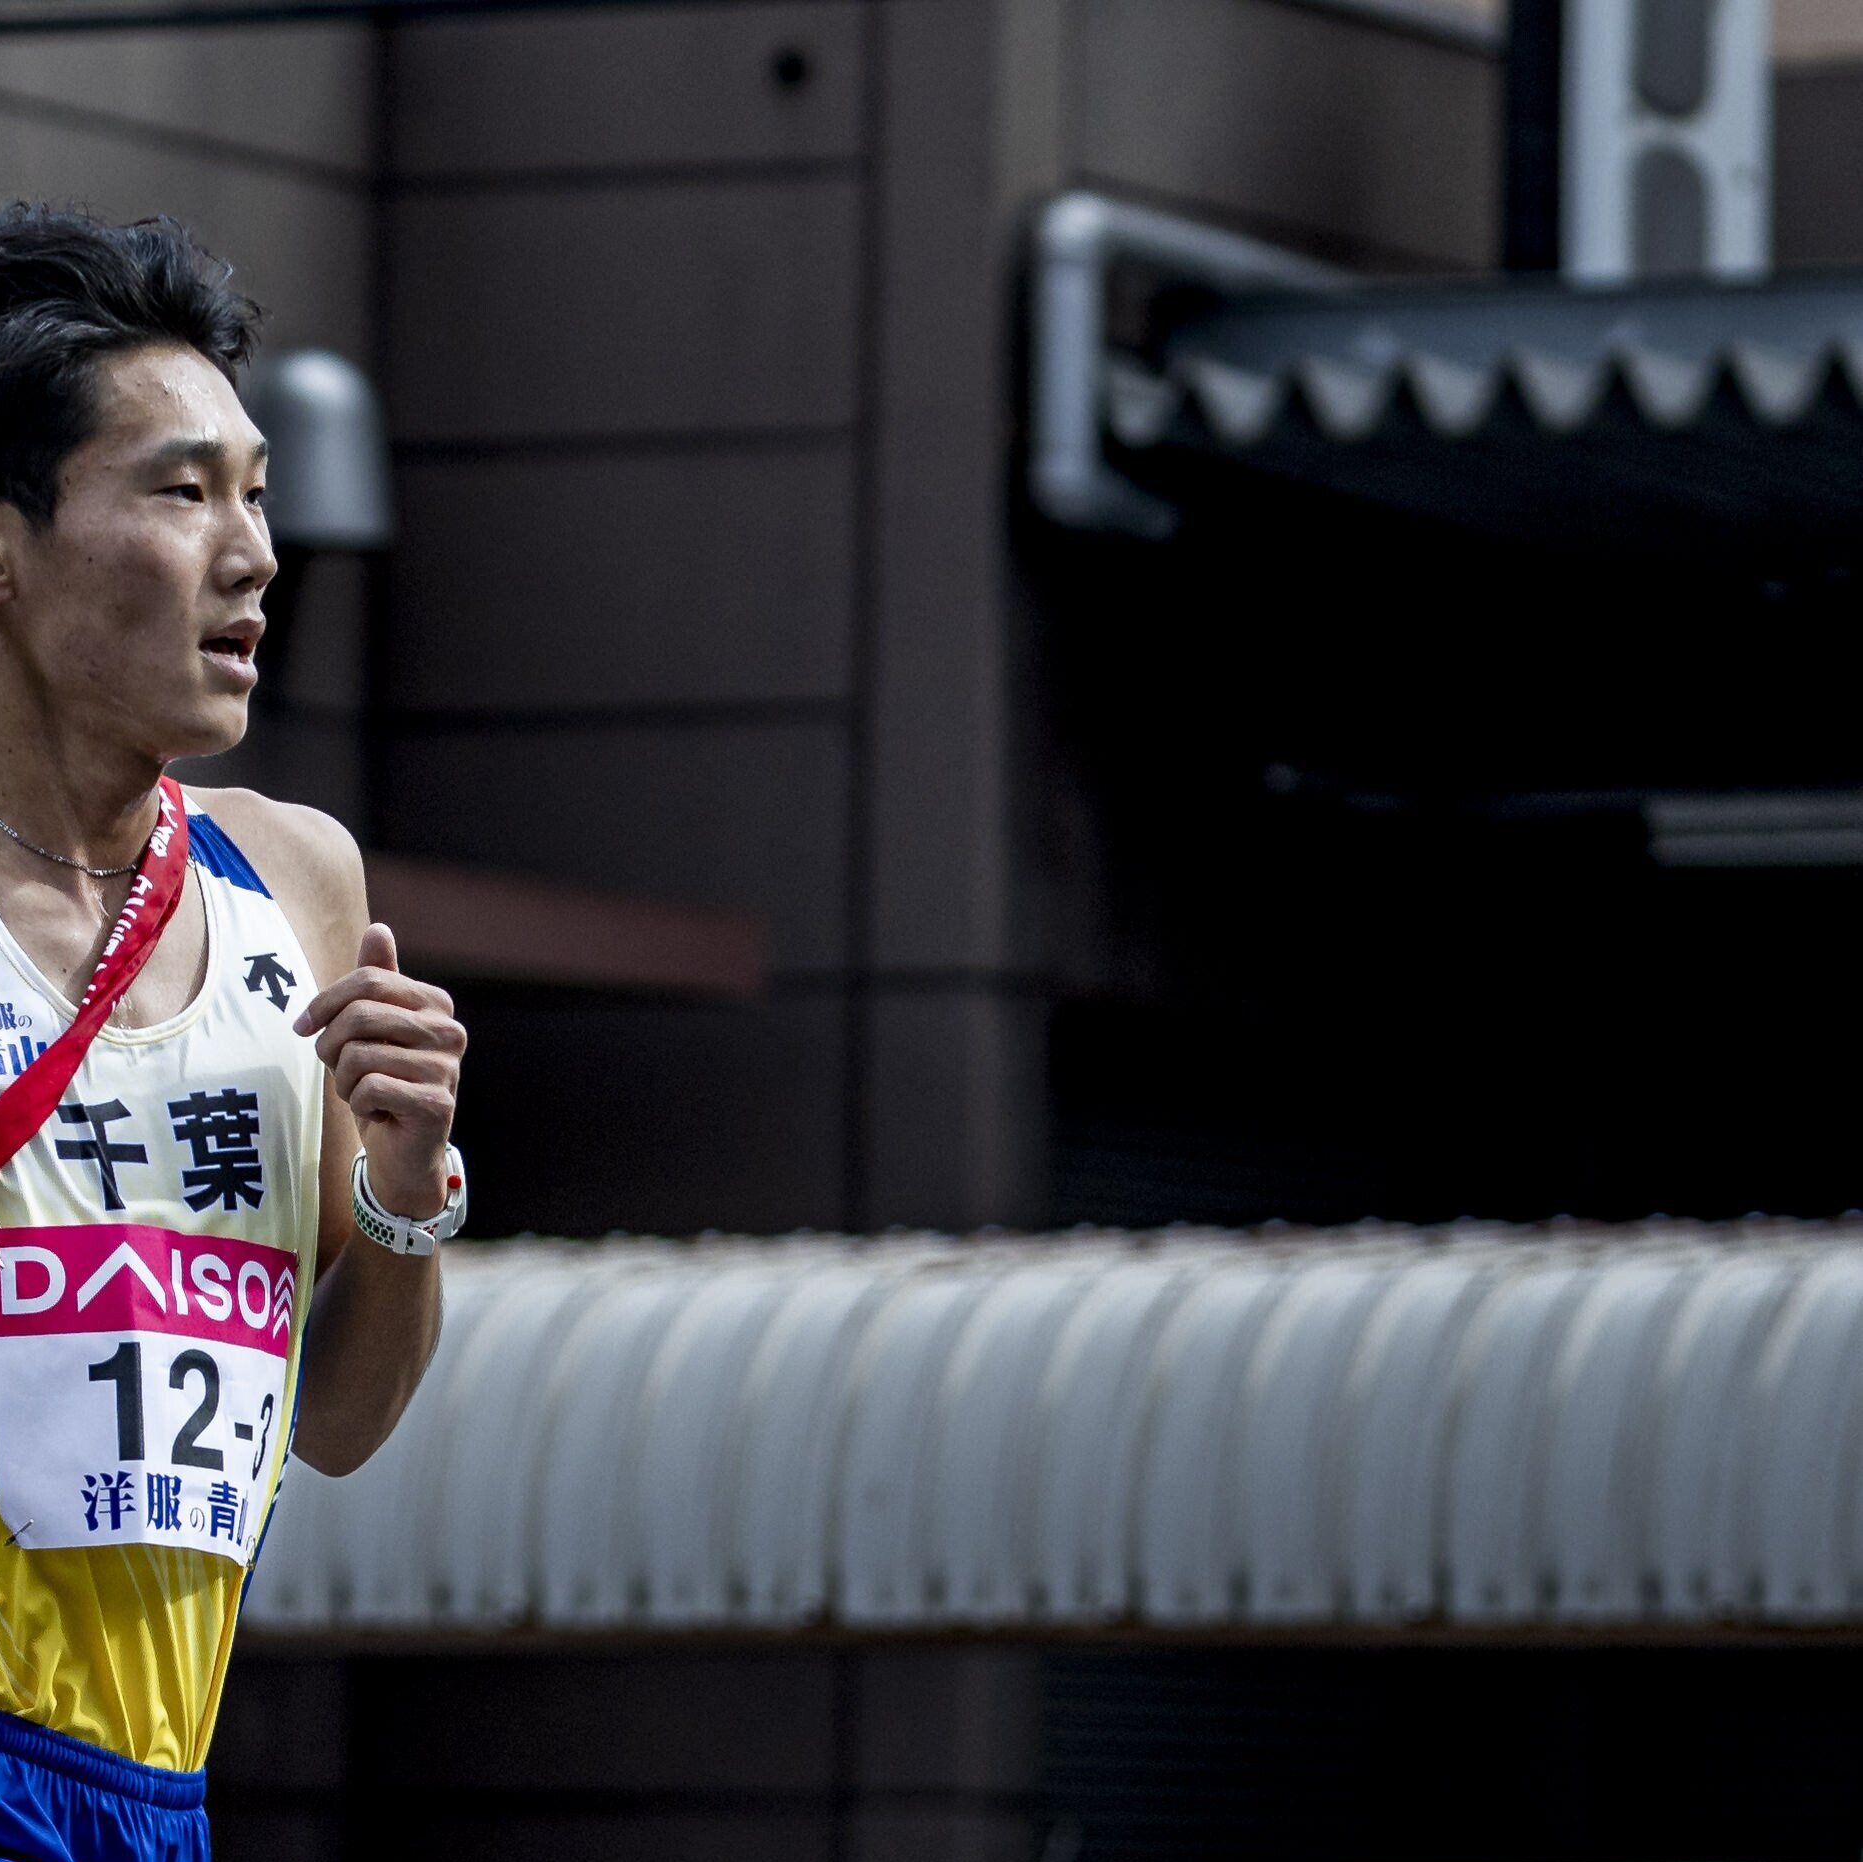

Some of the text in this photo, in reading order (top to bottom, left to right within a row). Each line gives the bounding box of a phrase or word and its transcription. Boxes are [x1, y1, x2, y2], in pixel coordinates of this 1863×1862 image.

[54, 1088, 265, 1213] 千葉
[0, 1241, 271, 1330] DAISO
[88, 1341, 275, 1482] 12-3
